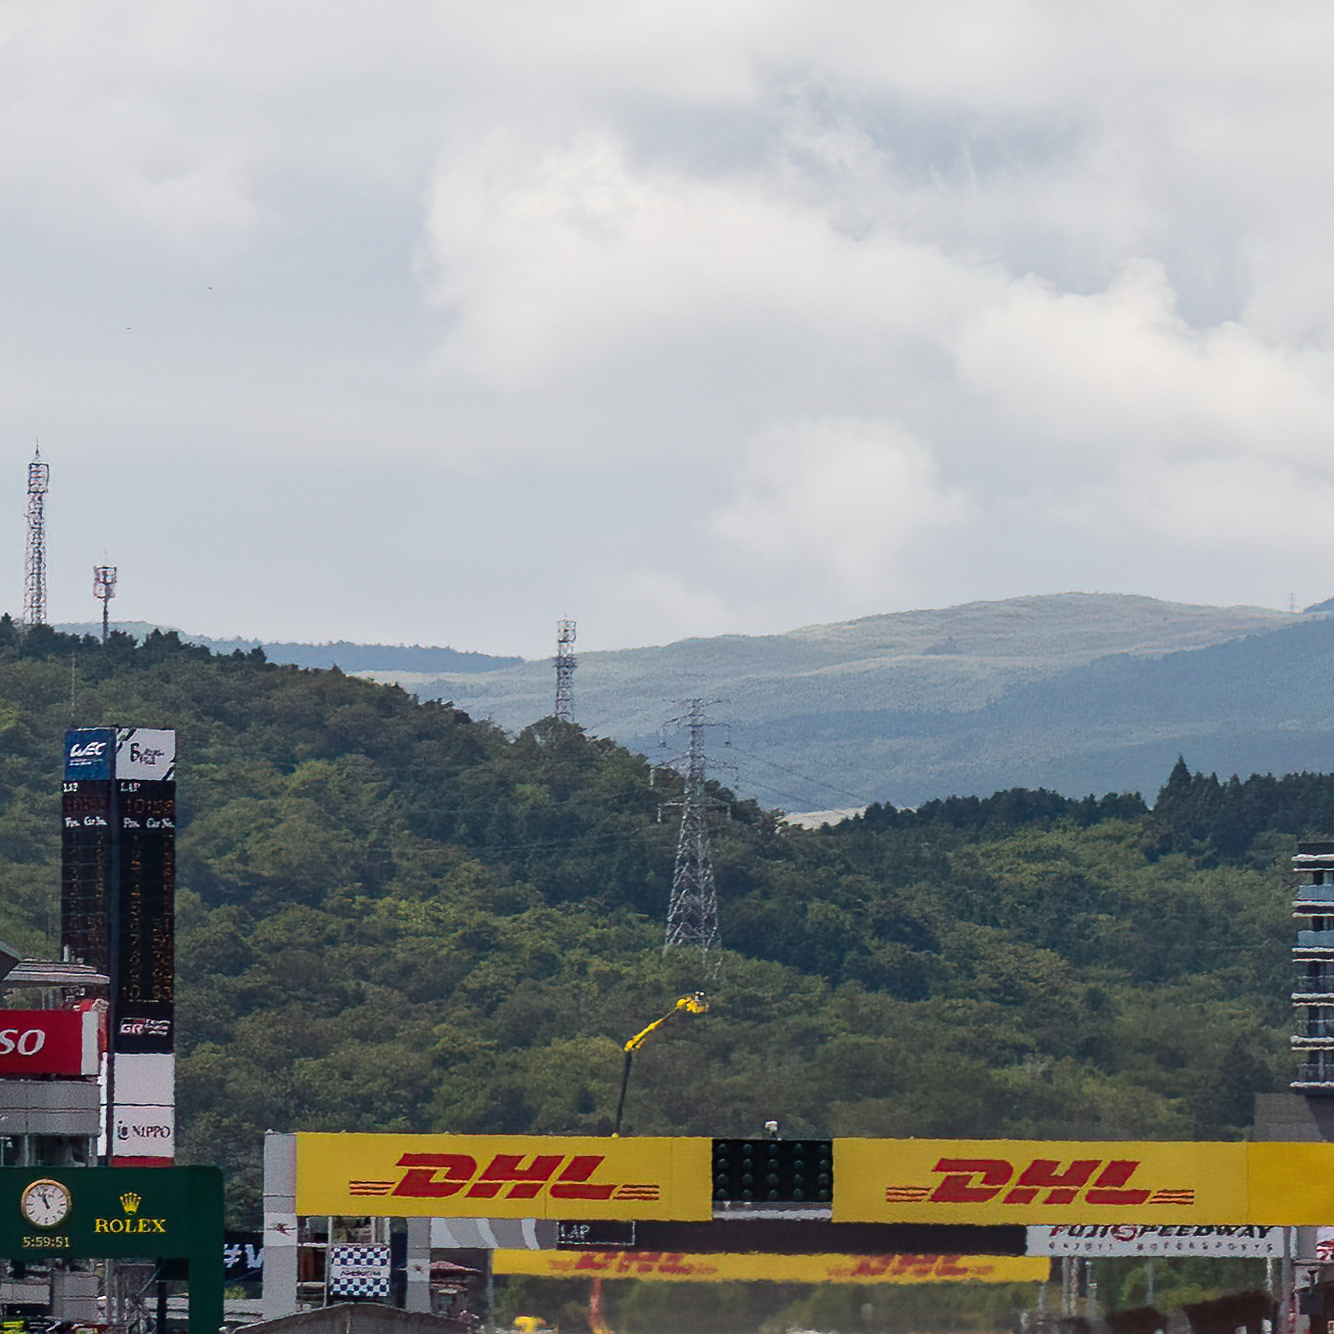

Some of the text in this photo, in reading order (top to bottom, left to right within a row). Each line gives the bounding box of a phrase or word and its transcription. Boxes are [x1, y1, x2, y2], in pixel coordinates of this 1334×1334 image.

[70, 742, 107, 757] WEC
[132, 1125, 171, 1139] NIPPO
[392, 1153, 618, 1200] DHL
[927, 1158, 1152, 1205] DHL
[94, 1218, 167, 1233] ROLEX
[559, 1225, 589, 1239] LAP
[23, 1237, 70, 1248] 5:59:51
